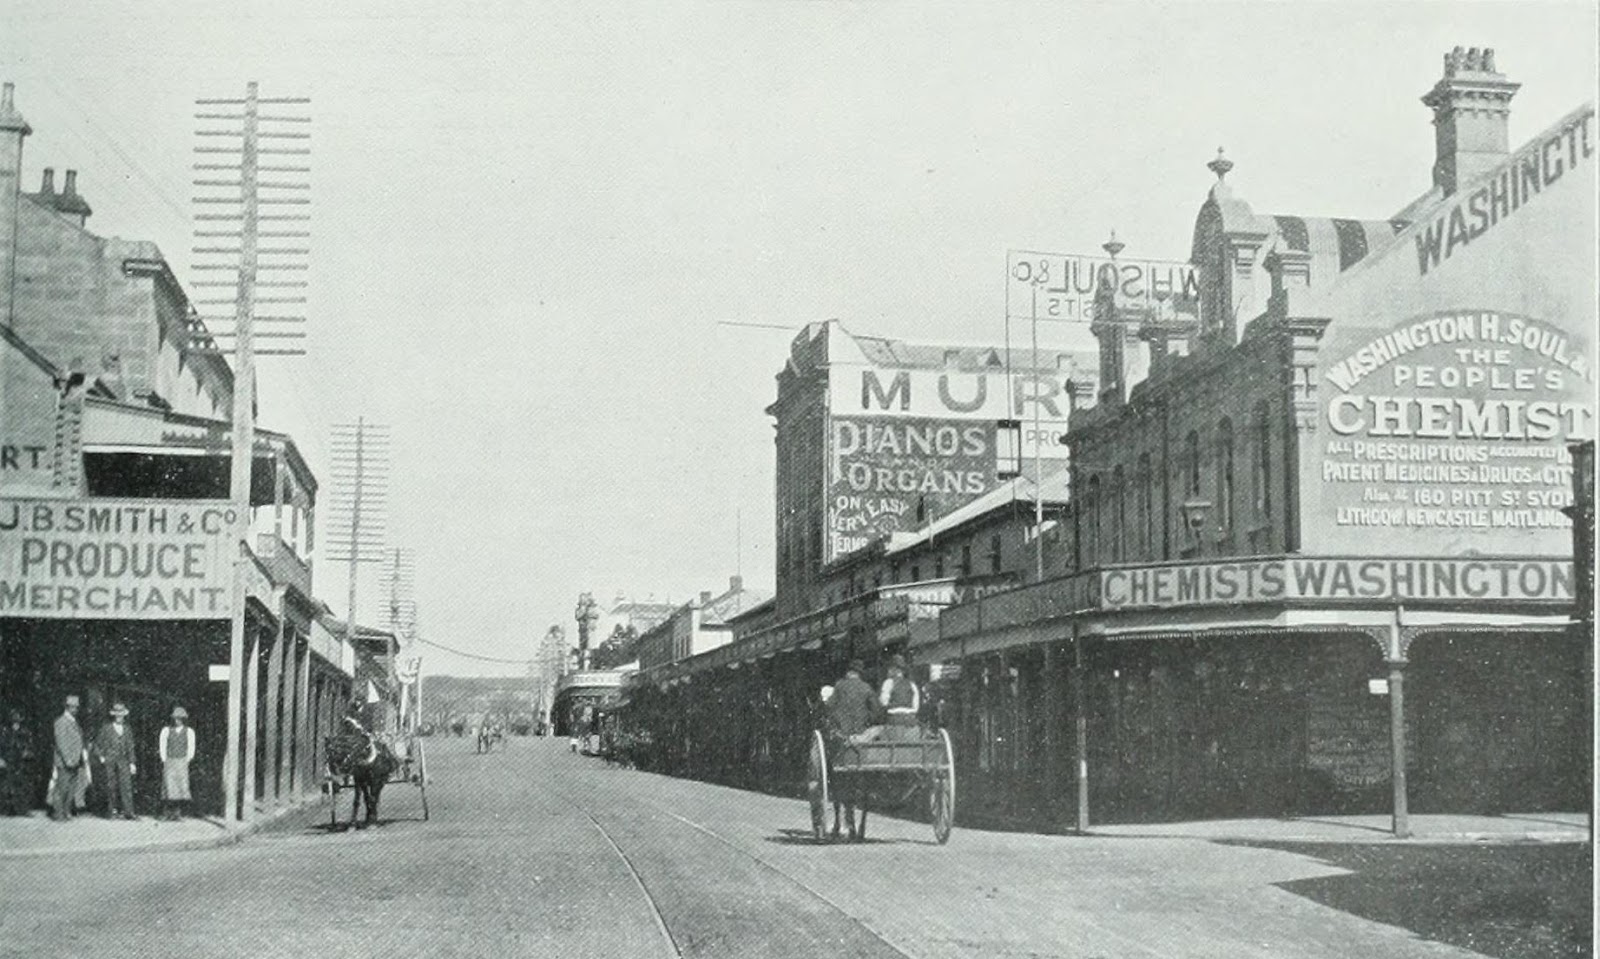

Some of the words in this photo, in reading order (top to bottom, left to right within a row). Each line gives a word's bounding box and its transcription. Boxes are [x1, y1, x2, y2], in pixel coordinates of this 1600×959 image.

[1325, 315, 1475, 393] WASHINGTON
[1455, 348, 1512, 365] THE
[1394, 365, 1564, 390] PEOPLE'S
[1327, 394, 1594, 441] CHEMIST
[832, 419, 987, 480] PIANOS
[1353, 440, 1488, 463] PRESCRIPTIONS
[848, 463, 986, 494] ORGANS
[1322, 459, 1383, 482] PATENT
[1383, 462, 1470, 484] MEDICINES
[836, 495, 861, 509] ON
[1413, 488, 1444, 507] 160
[1450, 489, 1494, 507] PITT
[176, 512, 195, 534] &
[830, 506, 868, 531] VERY
[868, 499, 909, 517] EASY
[1405, 508, 1489, 528] NEWCASTLE
[22, 537, 206, 580] PRODUCE
[1103, 562, 1285, 606] CHEMISTS
[1291, 561, 1575, 598] WASHINGTON
